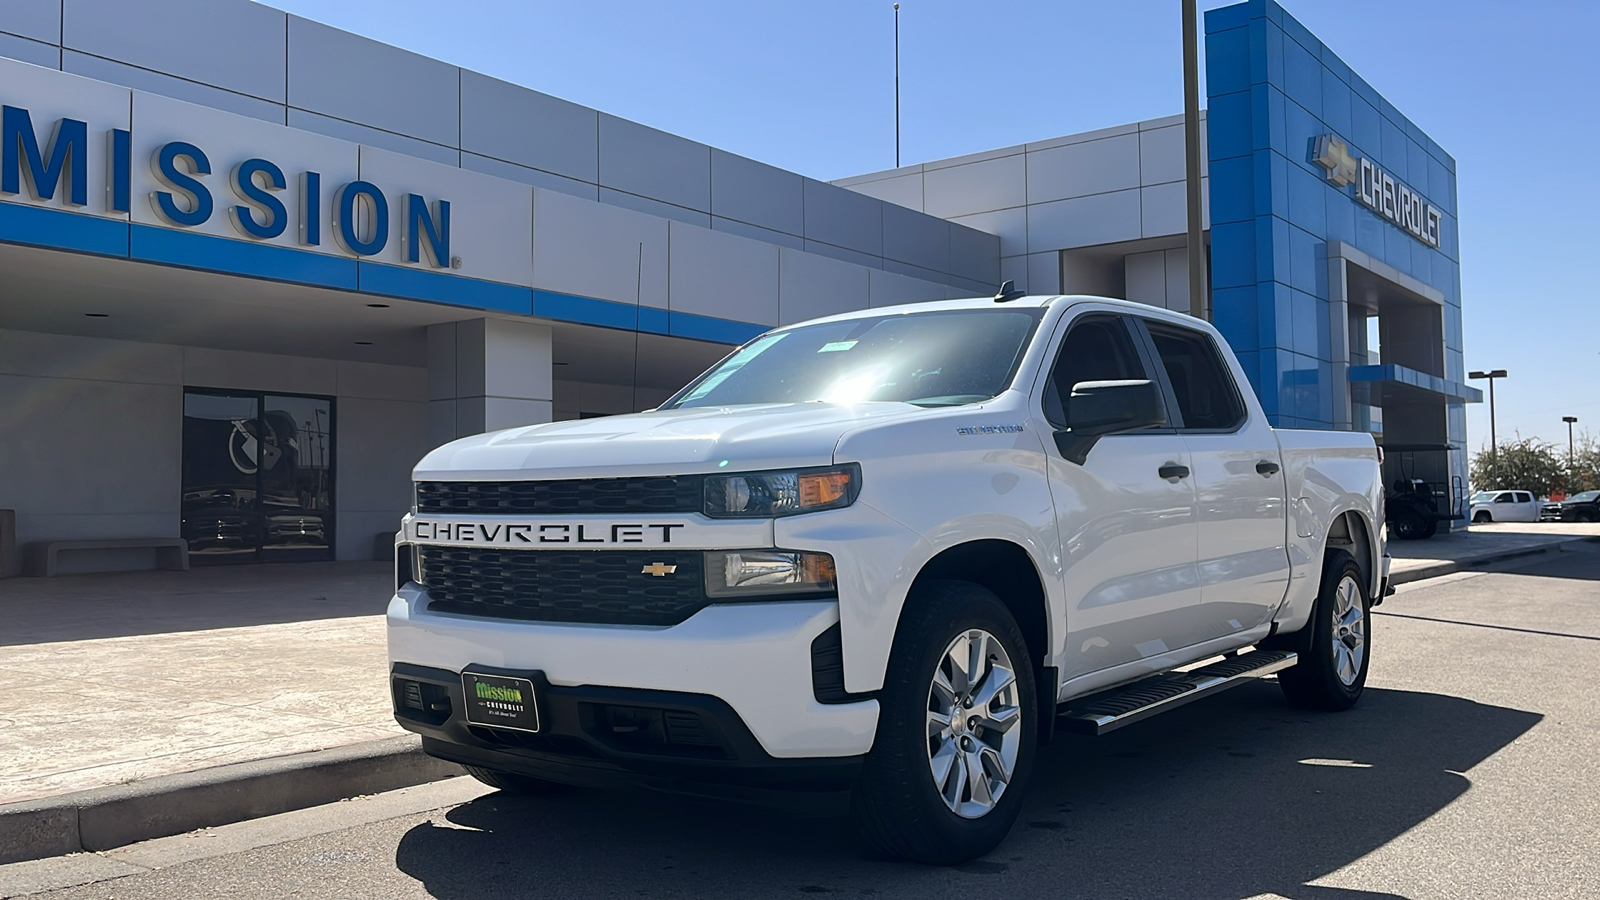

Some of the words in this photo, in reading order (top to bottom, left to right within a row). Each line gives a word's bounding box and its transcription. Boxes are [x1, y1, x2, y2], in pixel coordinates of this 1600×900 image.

[1, 104, 451, 268] MISSION
[1358, 157, 1442, 248] CHEVROLET
[415, 521, 684, 543] CHEVROLET
[476, 682, 522, 702] Mission
[486, 702, 524, 712] CHEVROLET
